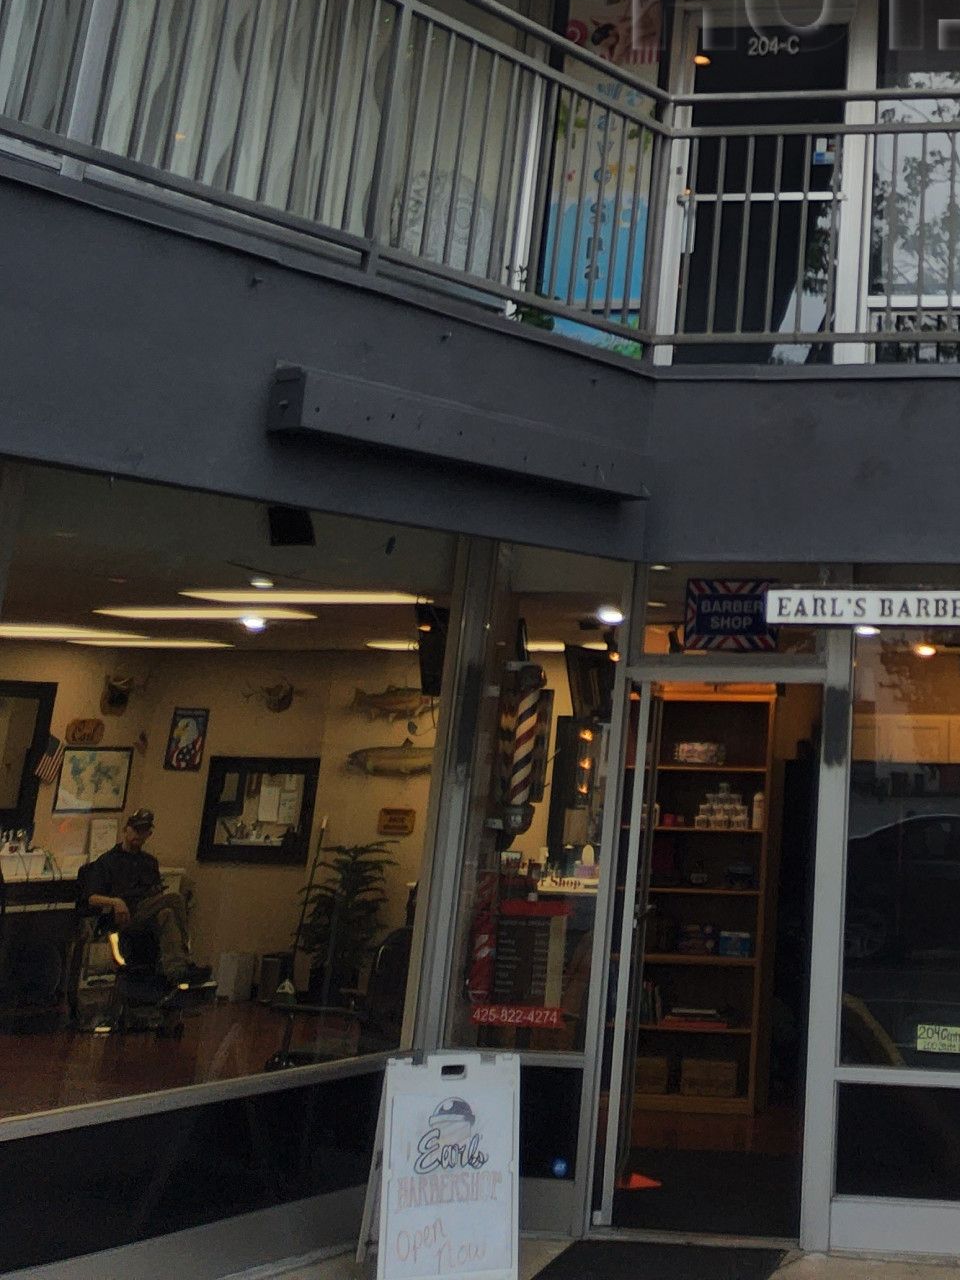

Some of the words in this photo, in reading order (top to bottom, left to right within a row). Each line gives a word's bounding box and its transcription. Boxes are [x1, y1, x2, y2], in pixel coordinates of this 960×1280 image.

[748, 36, 800, 56] 204-C
[701, 599, 762, 614] BARBER
[777, 596, 866, 618] EARL'S
[710, 616, 753, 629] SHOP
[473, 1007, 558, 1024] 425-822-4274
[396, 1171, 502, 1210] BARBERSHOP
[396, 1218, 448, 1263] Open
